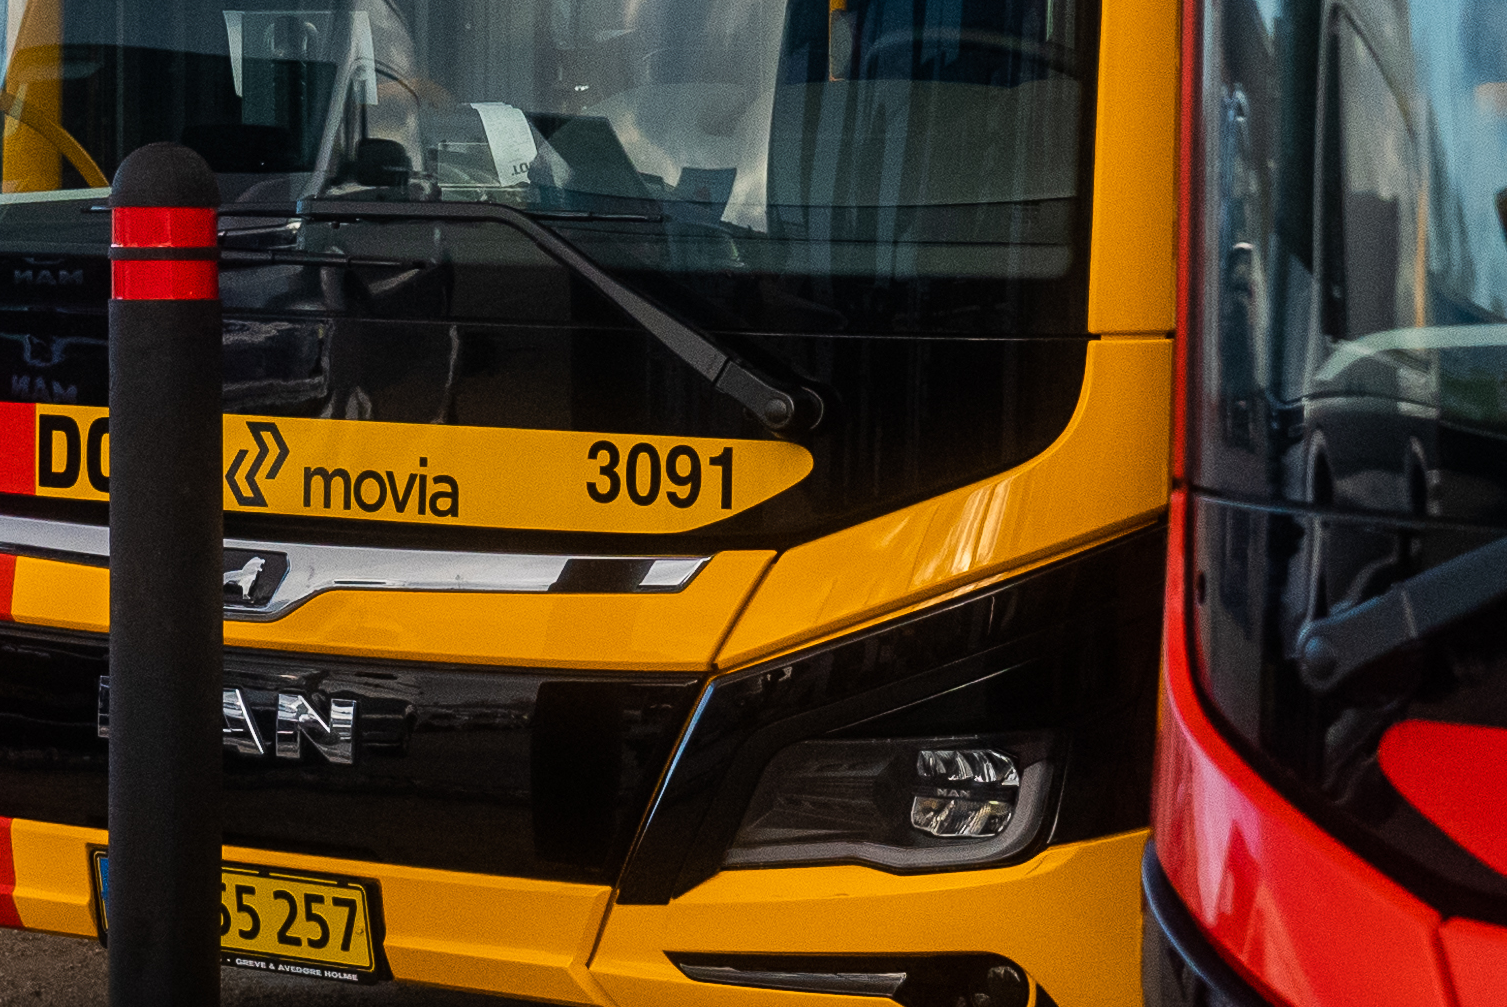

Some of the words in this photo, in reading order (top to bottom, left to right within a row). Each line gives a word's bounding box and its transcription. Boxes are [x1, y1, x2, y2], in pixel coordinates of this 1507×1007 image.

[303, 457, 459, 518] movia
[586, 439, 733, 510] 3091
[273, 888, 358, 952] 257
[235, 958, 267, 970] GREVE
[324, 970, 359, 982] HOLME
